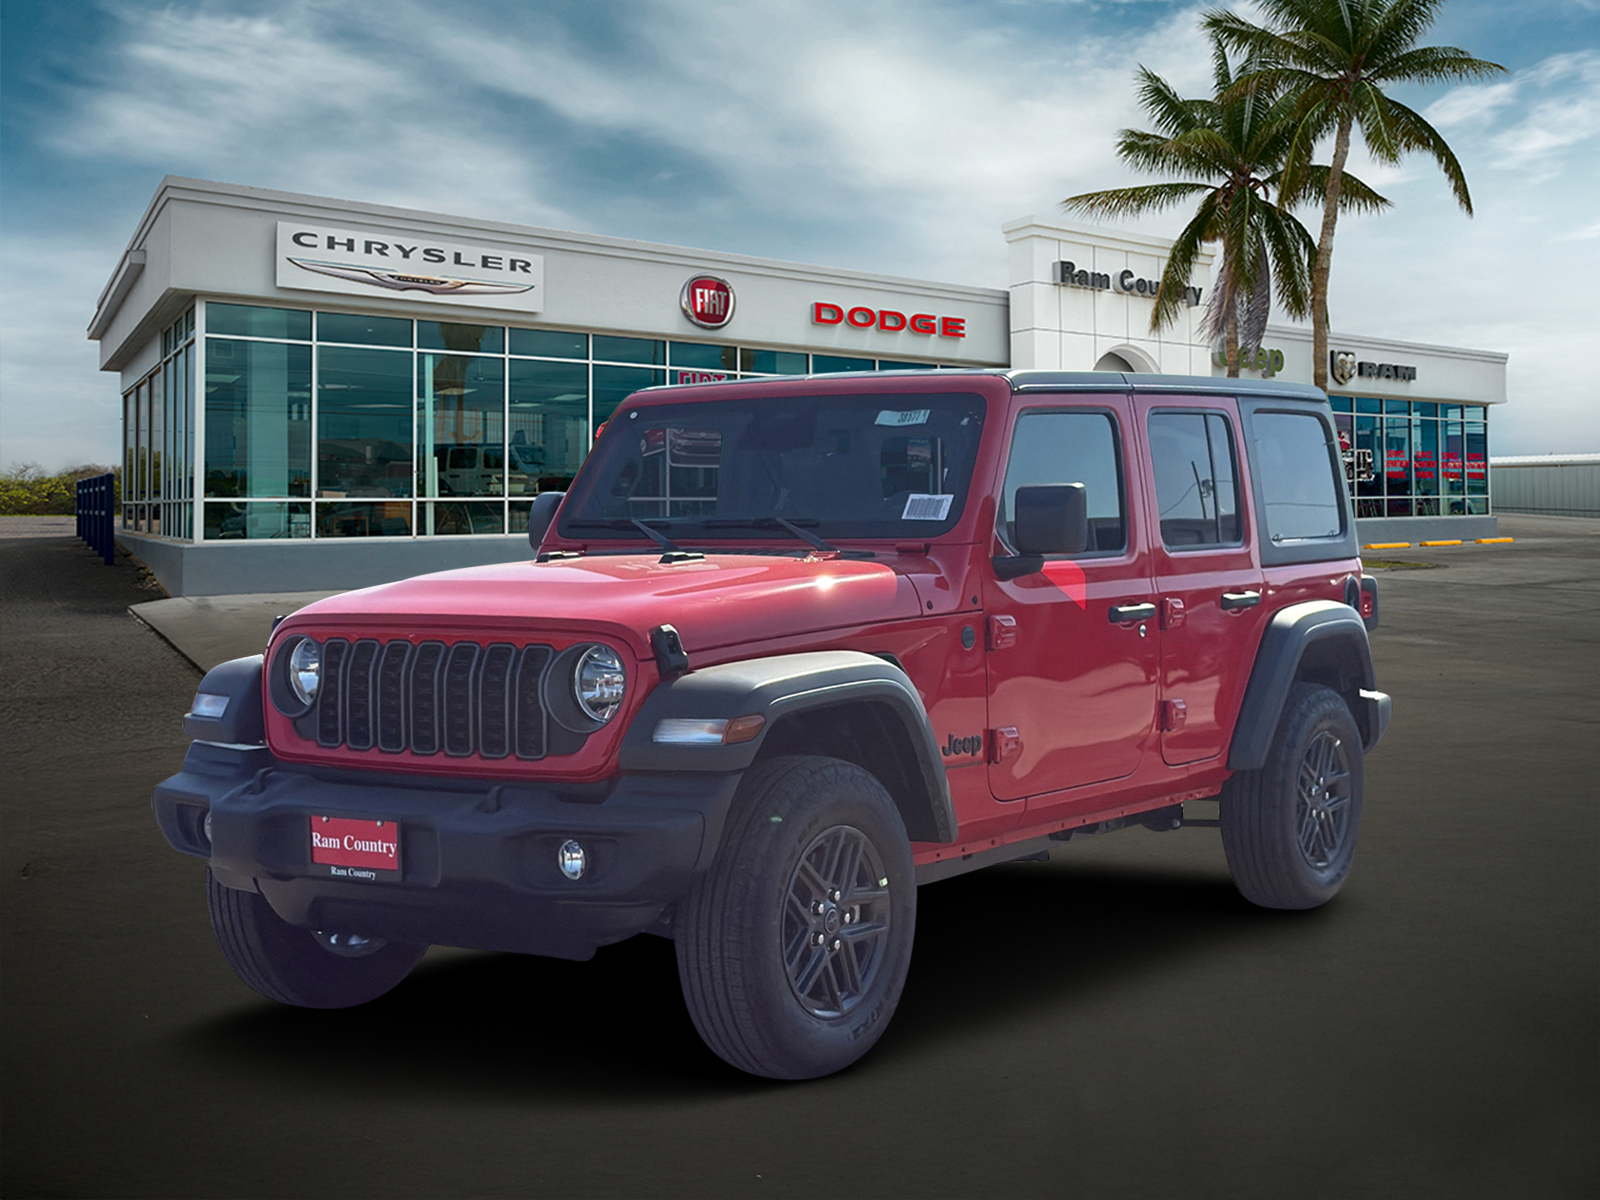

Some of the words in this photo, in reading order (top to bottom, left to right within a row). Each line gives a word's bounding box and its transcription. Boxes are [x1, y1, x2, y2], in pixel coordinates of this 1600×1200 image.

[292, 232, 533, 274] CHRYSLER
[1056, 260, 1110, 290] Ram
[1116, 269, 1202, 307] Coury
[695, 287, 728, 316] FIAT
[812, 301, 966, 338] DODGE
[1357, 361, 1416, 380] RAM
[942, 733, 982, 757] Jeep
[312, 832, 340, 849] Ram
[343, 835, 397, 857] Country
[331, 866, 347, 876] Ram
[348, 868, 376, 880] Country
